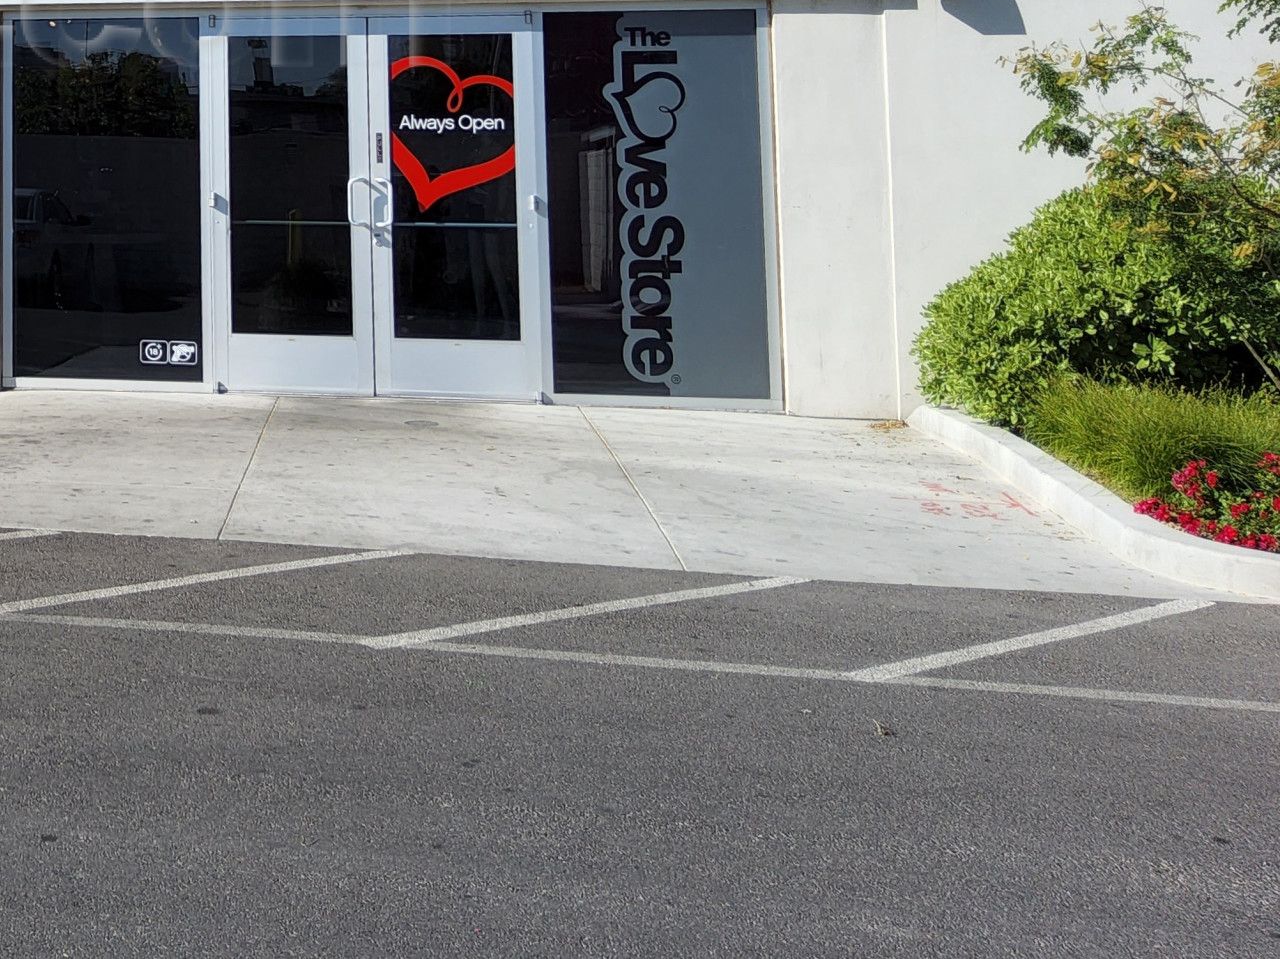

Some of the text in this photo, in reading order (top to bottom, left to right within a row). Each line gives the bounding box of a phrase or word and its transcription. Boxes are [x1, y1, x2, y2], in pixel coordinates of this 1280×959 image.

[624, 26, 672, 47] The
[399, 114, 505, 134] Always Open
